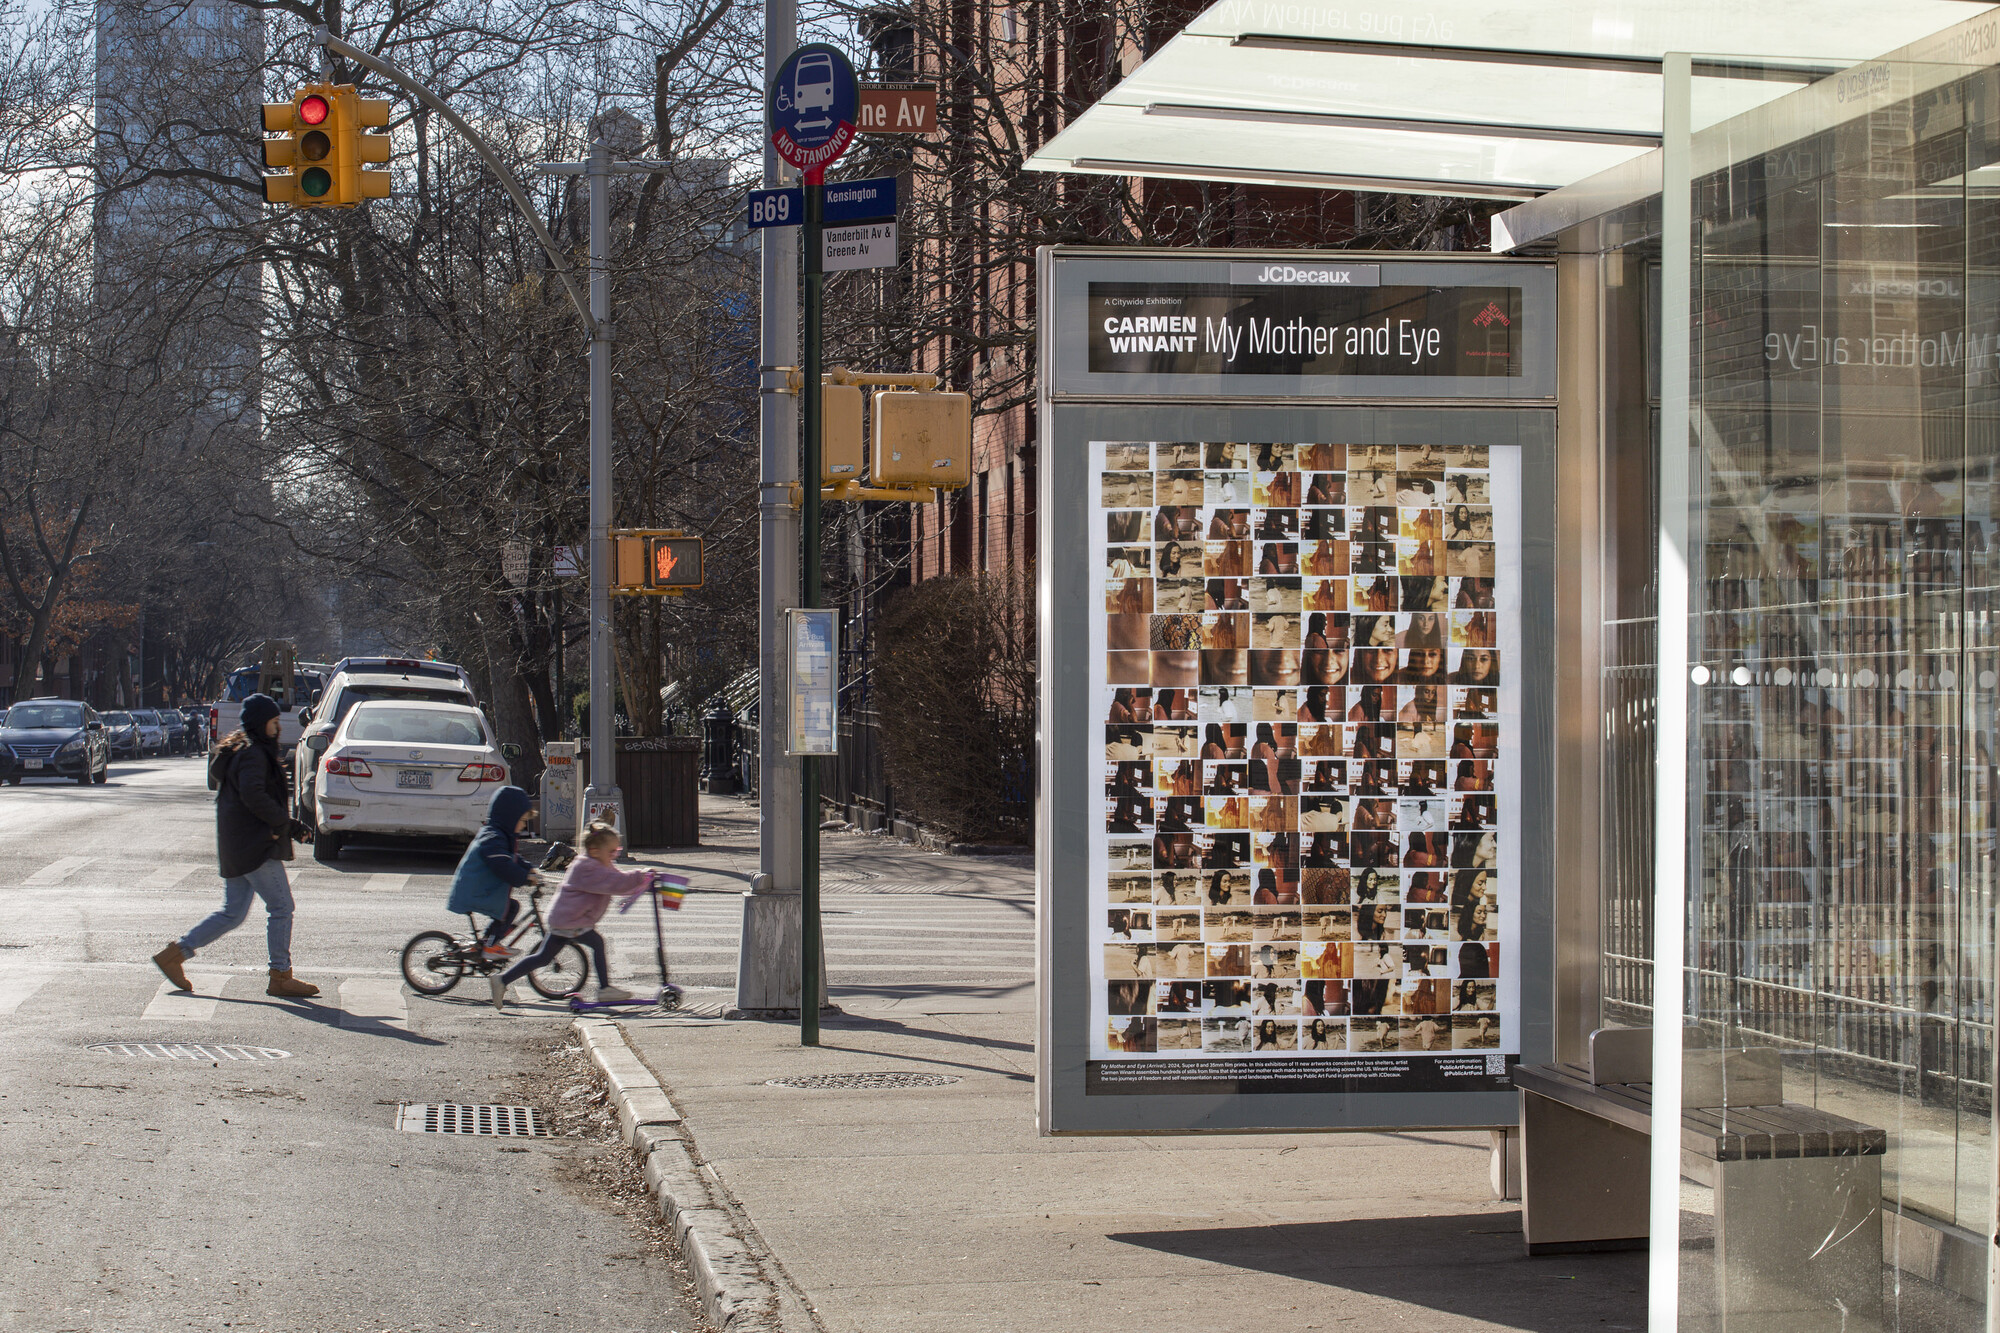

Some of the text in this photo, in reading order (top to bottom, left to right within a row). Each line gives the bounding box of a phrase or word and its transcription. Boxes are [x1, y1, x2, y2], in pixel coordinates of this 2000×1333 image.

[856, 97, 925, 127] ne Av
[778, 127, 849, 165] NO STANDING
[827, 188, 877, 205] Kensington
[753, 195, 789, 223] B69
[826, 227, 891, 244] Vanderbilt Av &
[826, 244, 869, 258] Greene Av
[1258, 266, 1351, 283] JCDecaux
[1112, 298, 1144, 307] Citywide
[1146, 297, 1182, 306] Exhibition
[1472, 302, 1496, 326] PUBLIC
[1104, 316, 1196, 334] CARMEN
[1109, 336, 1197, 353] WINANT
[1205, 316, 1441, 364] My Mother and Eye
